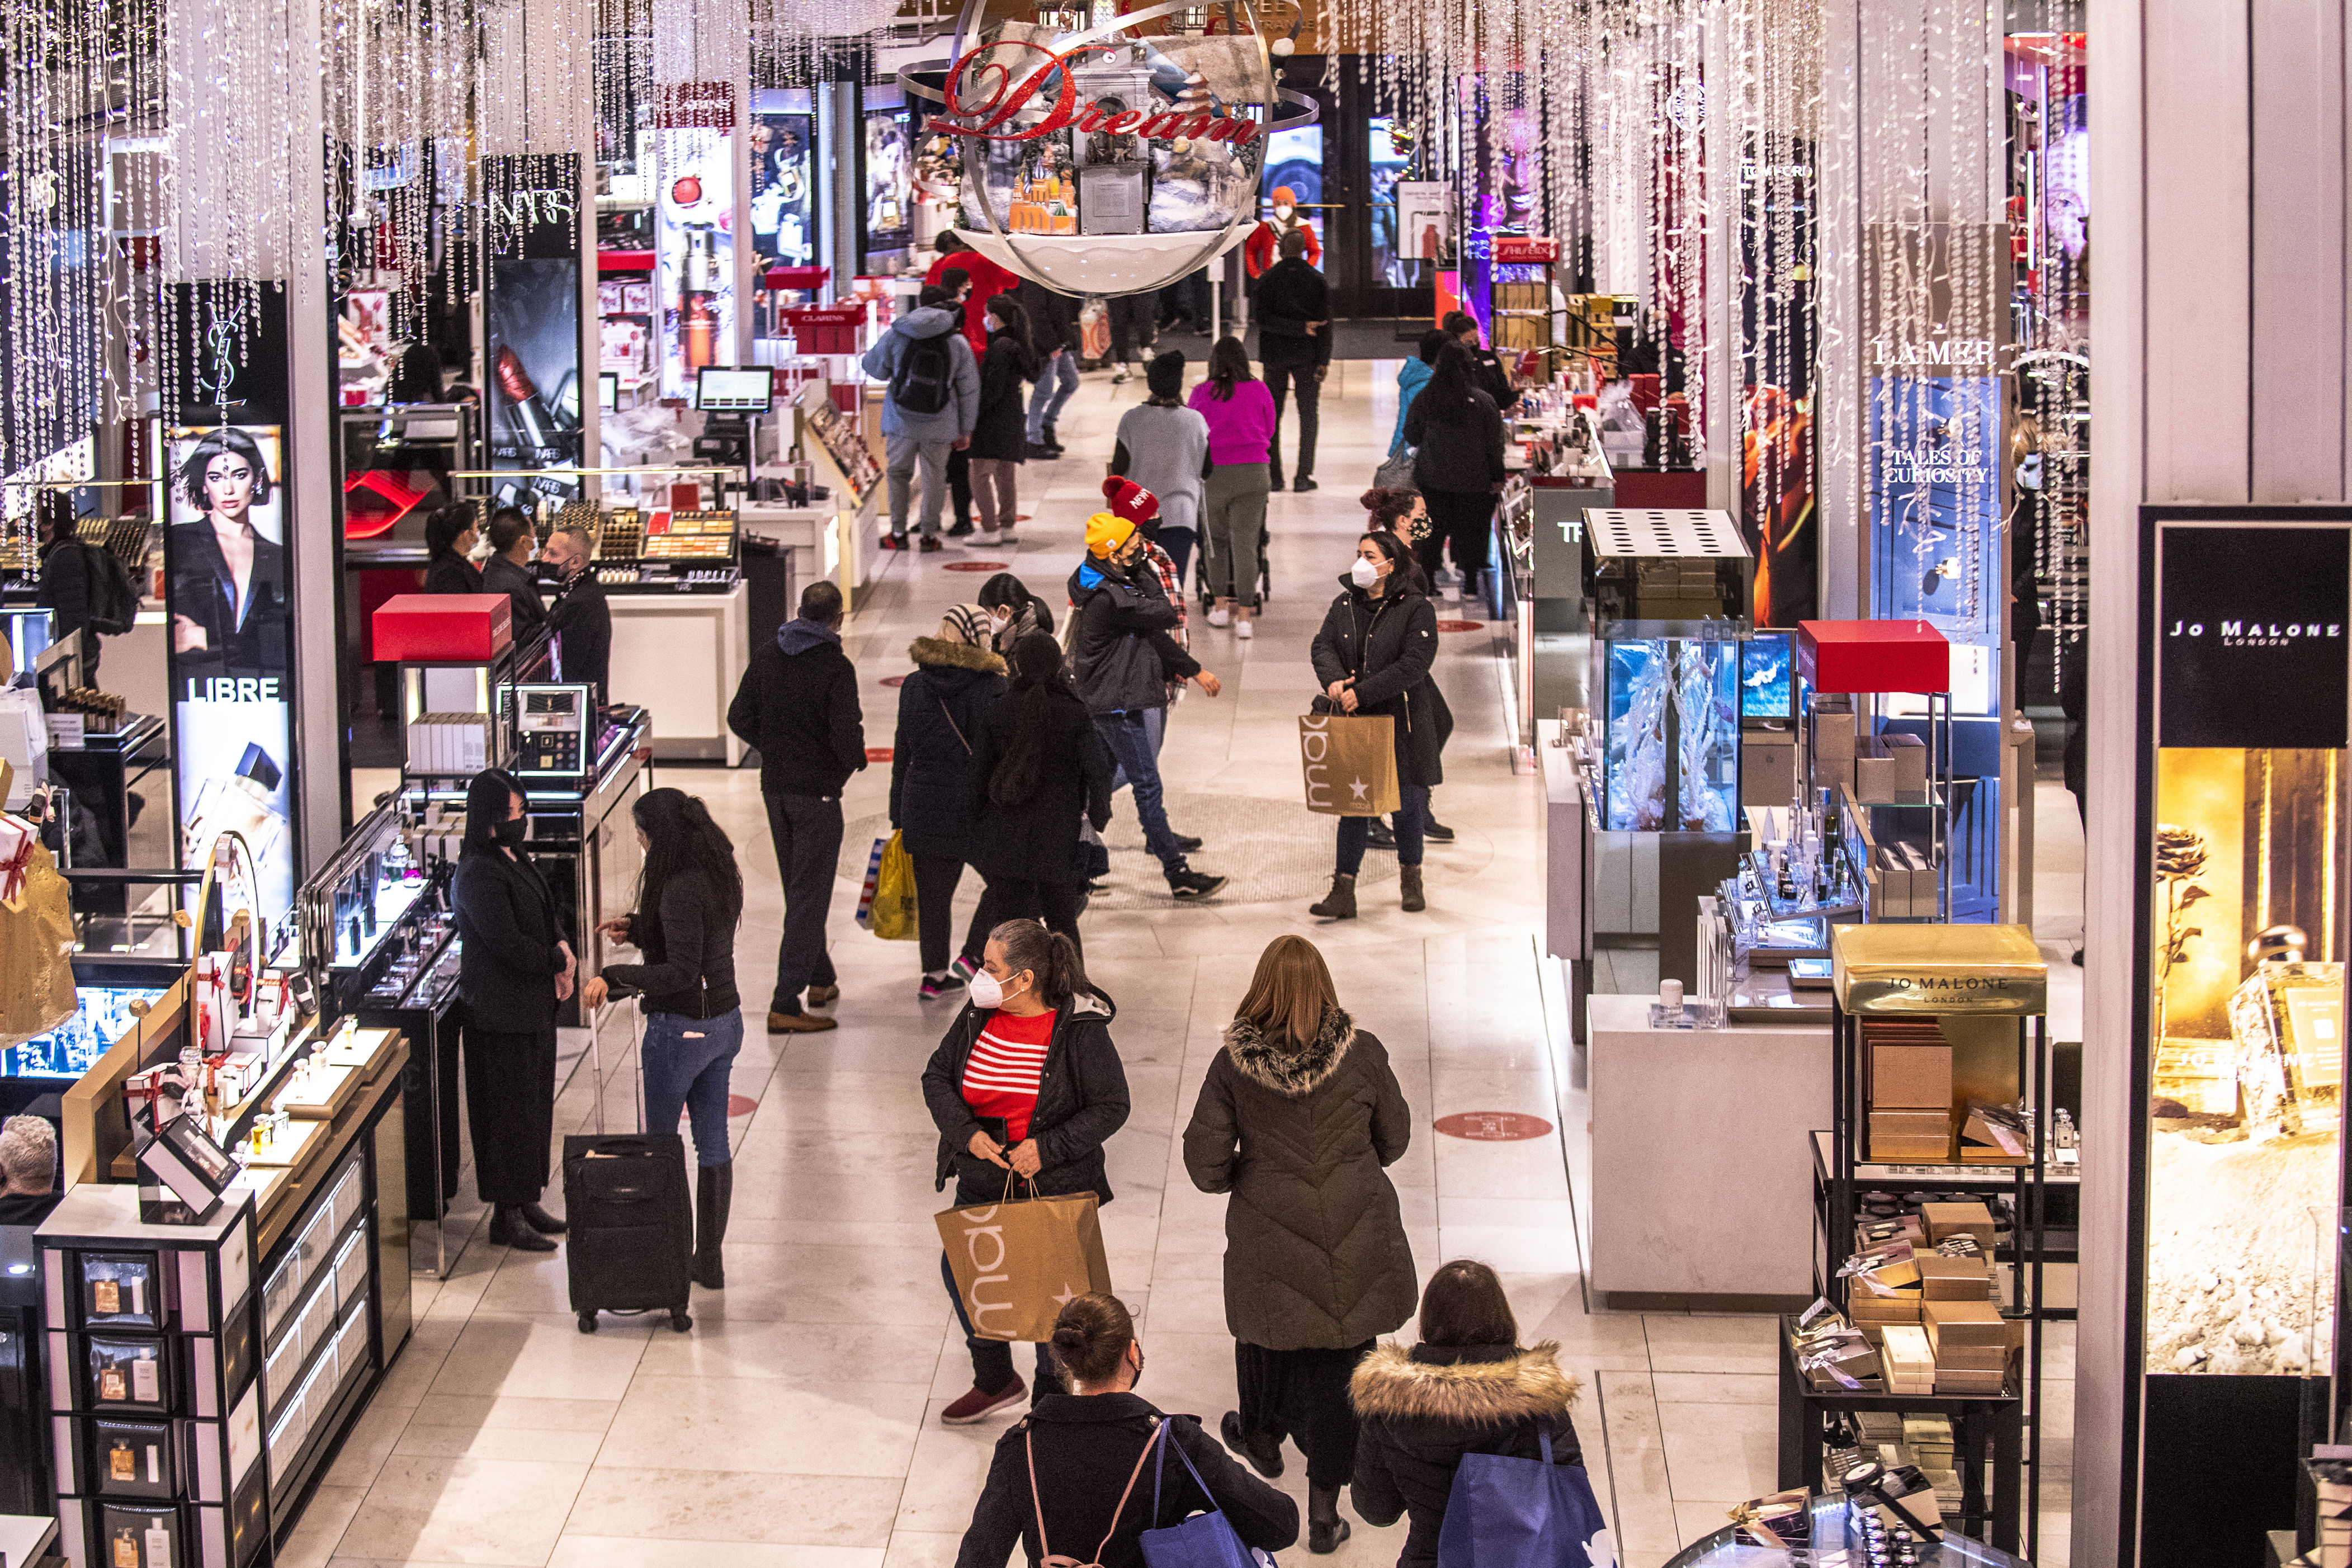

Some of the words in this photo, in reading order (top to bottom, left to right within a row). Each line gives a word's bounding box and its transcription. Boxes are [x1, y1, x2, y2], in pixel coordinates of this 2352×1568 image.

[928, 41, 1262, 145] Dream
[1873, 341, 1918, 365] LA
[1926, 341, 1997, 365] MER
[1892, 450, 1952, 465] TALES
[187, 677, 280, 702] LIBRE
[1887, 977, 1912, 989] JO
[1919, 977, 2009, 989] MALONE
